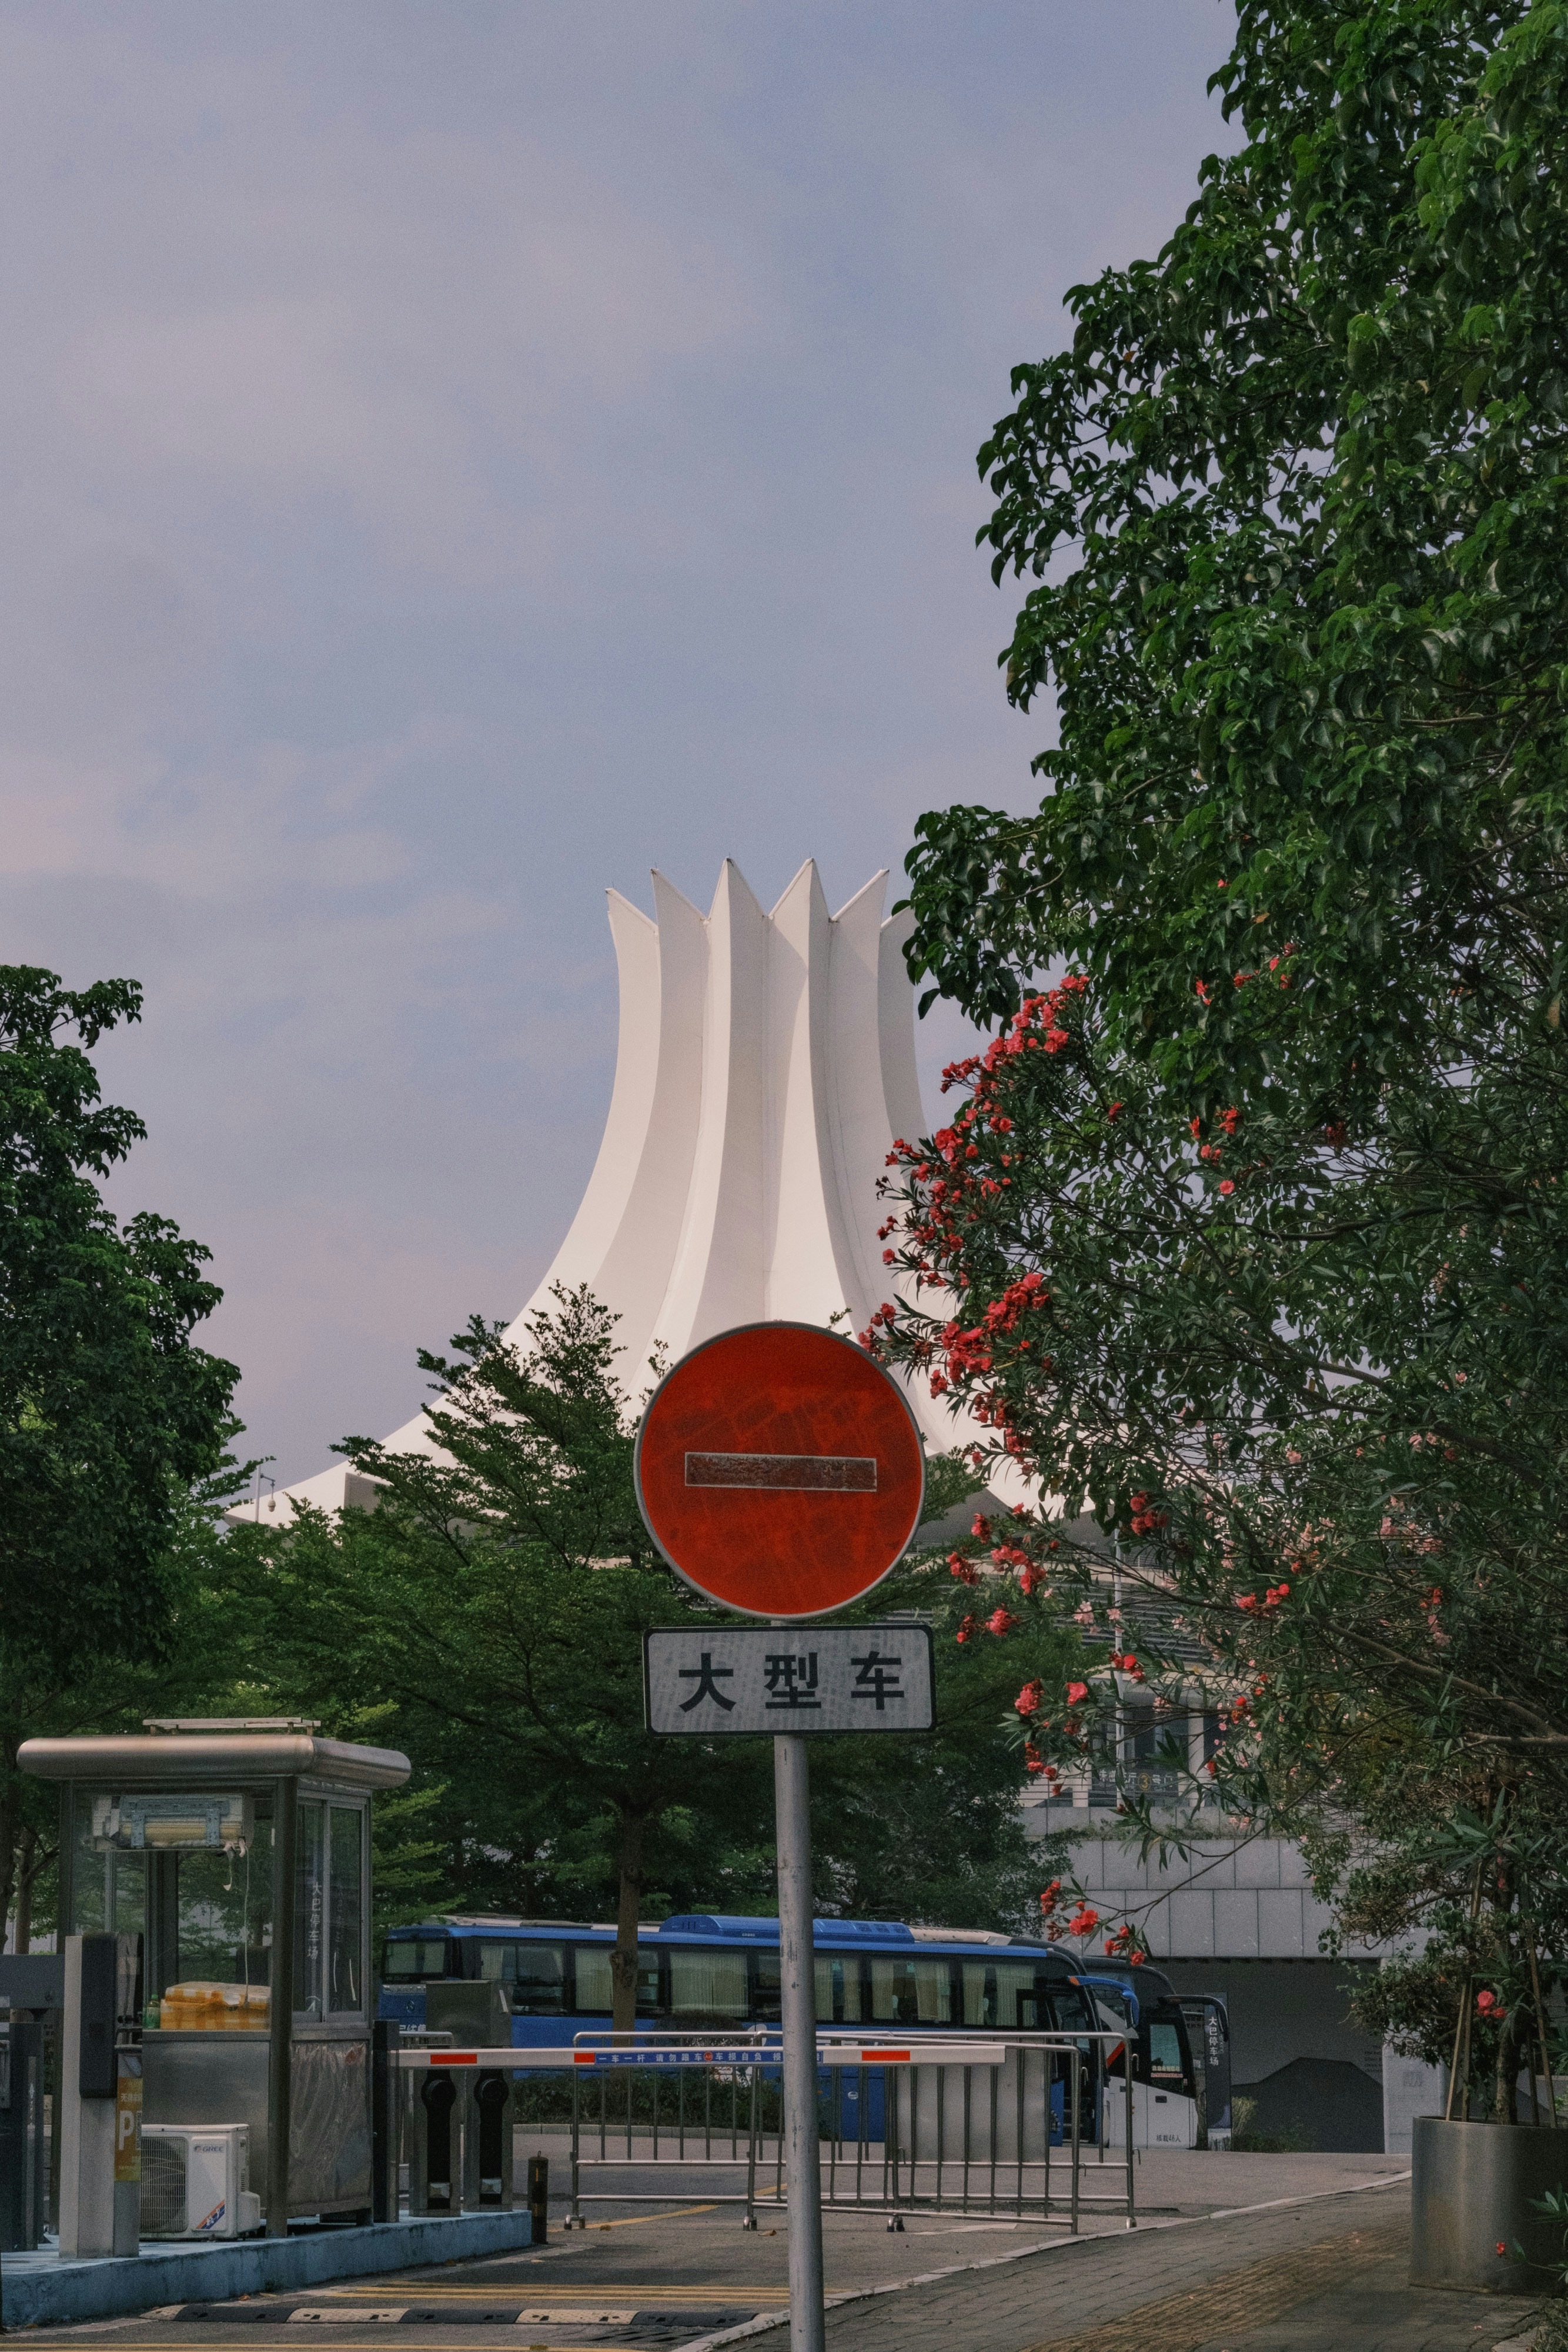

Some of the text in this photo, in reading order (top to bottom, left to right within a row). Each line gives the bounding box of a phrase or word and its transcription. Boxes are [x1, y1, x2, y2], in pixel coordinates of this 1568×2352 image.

[678, 1651, 905, 1712] 大型车
[599, 2054, 645, 2063] 一车一杆
[656, 2053, 702, 2062] 请勿跟车
[716, 2052, 761, 2061] 车损自负
[1208, 2016, 1219, 2066] 大巴停车场
